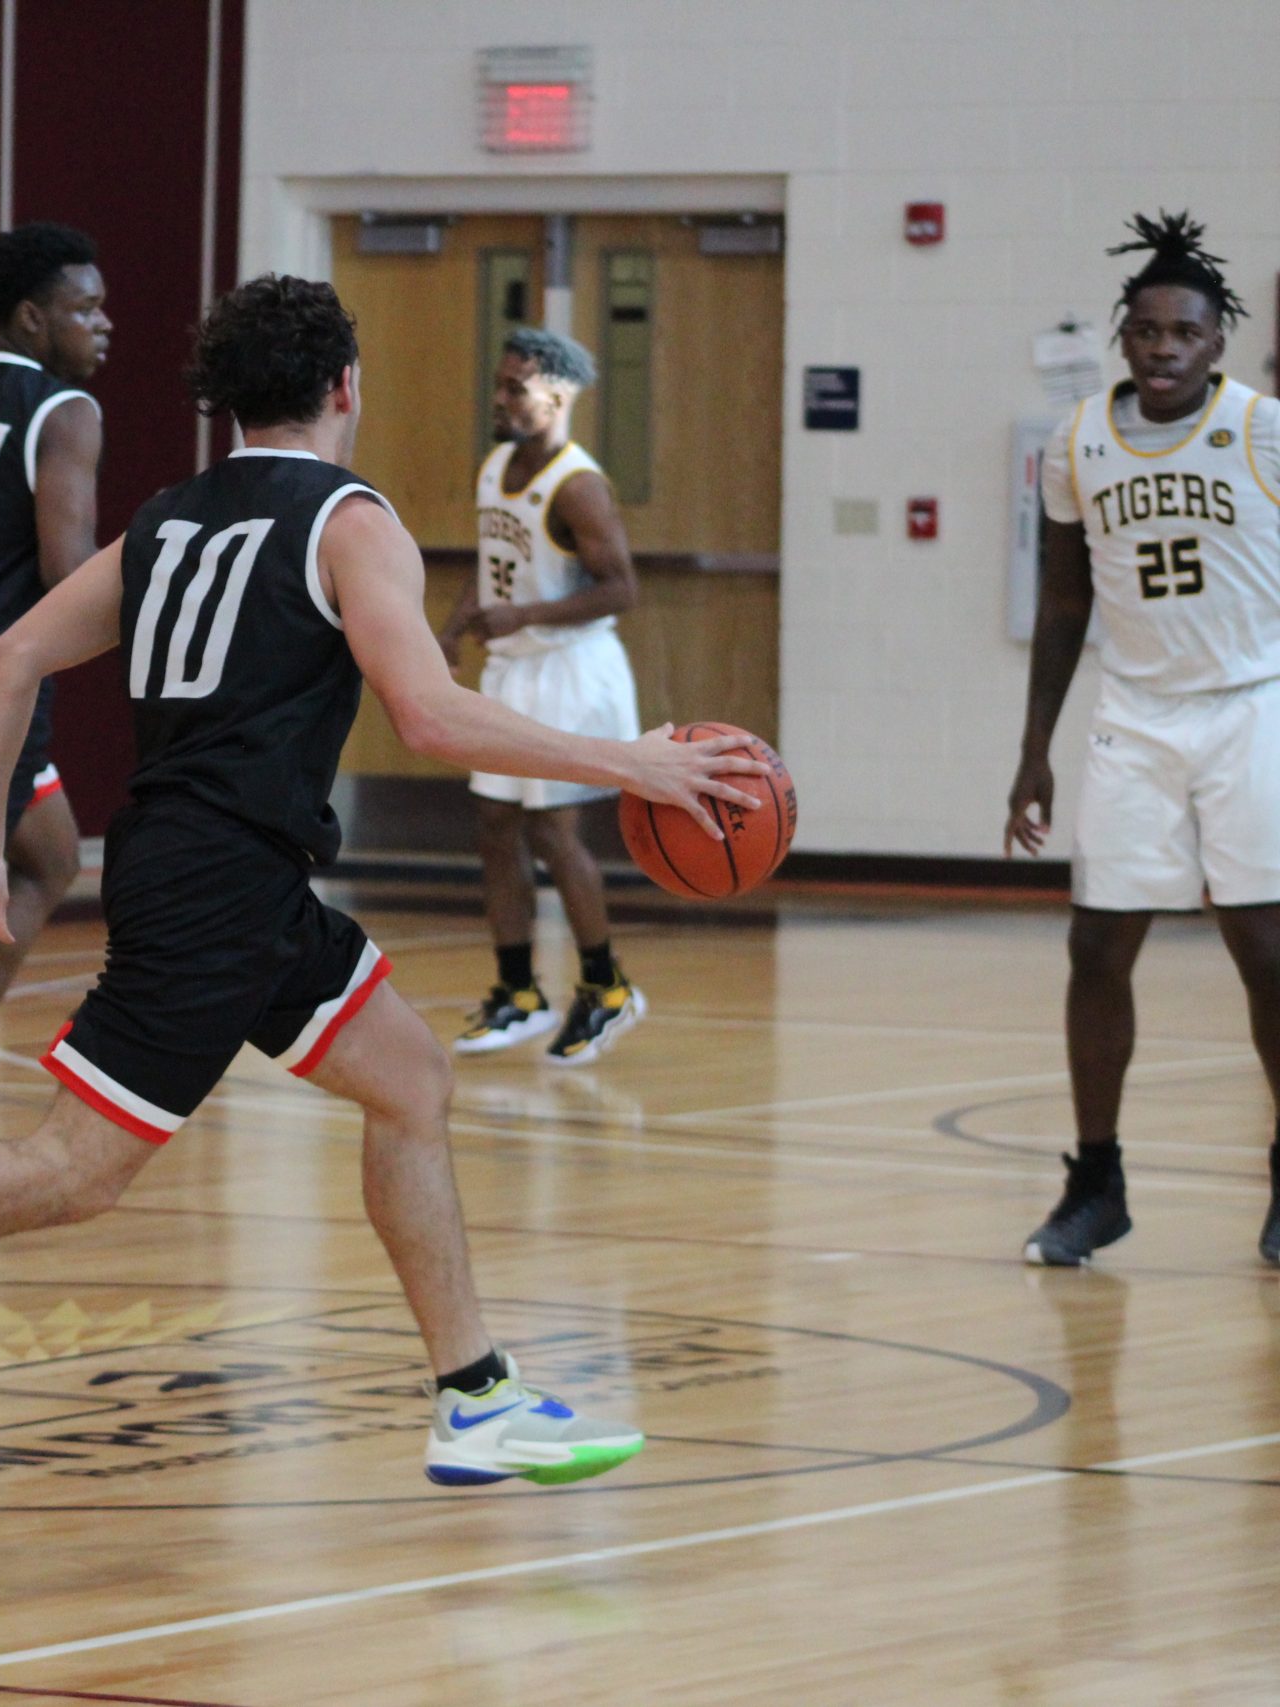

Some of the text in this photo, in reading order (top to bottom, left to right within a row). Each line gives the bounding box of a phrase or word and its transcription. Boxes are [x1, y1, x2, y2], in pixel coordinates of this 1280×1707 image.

[1092, 472, 1235, 535] TIGERS
[1136, 536, 1205, 600] 25
[129, 517, 276, 699] 10
